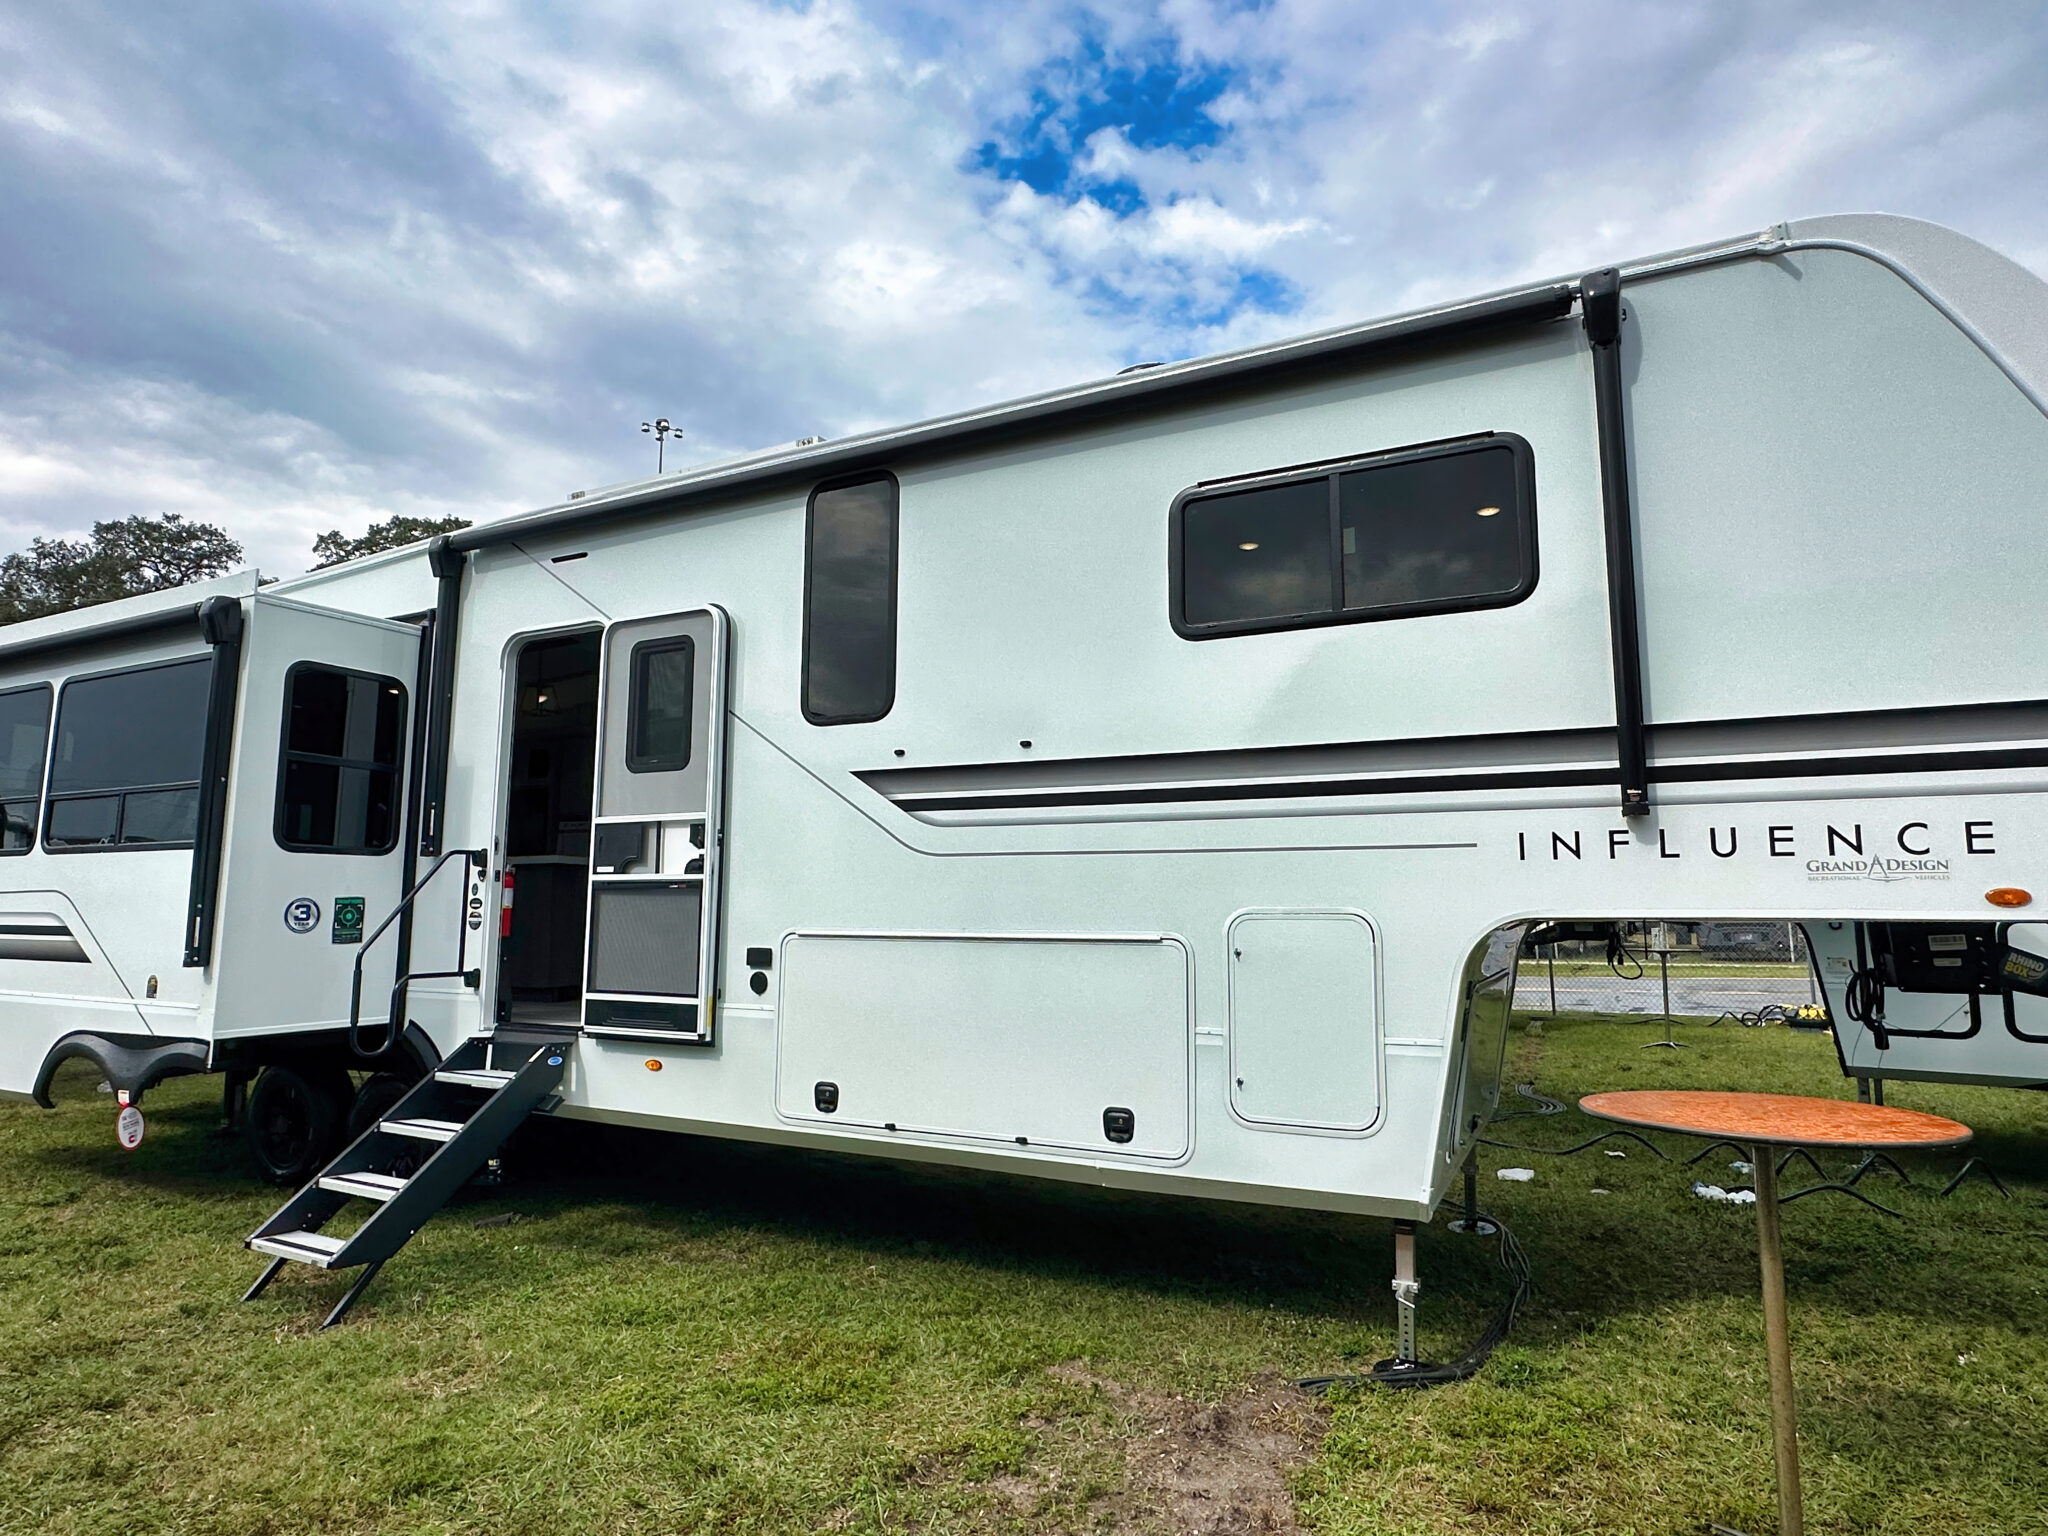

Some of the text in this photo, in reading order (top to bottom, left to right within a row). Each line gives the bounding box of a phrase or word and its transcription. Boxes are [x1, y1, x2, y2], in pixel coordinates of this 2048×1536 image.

[1519, 820, 1996, 861] INFLUENCE
[1806, 858, 1949, 872] GRAND DESIGN
[293, 904, 311, 921] 3
[2004, 961, 2029, 978] BOX
[2008, 952, 2044, 972] RHINO
